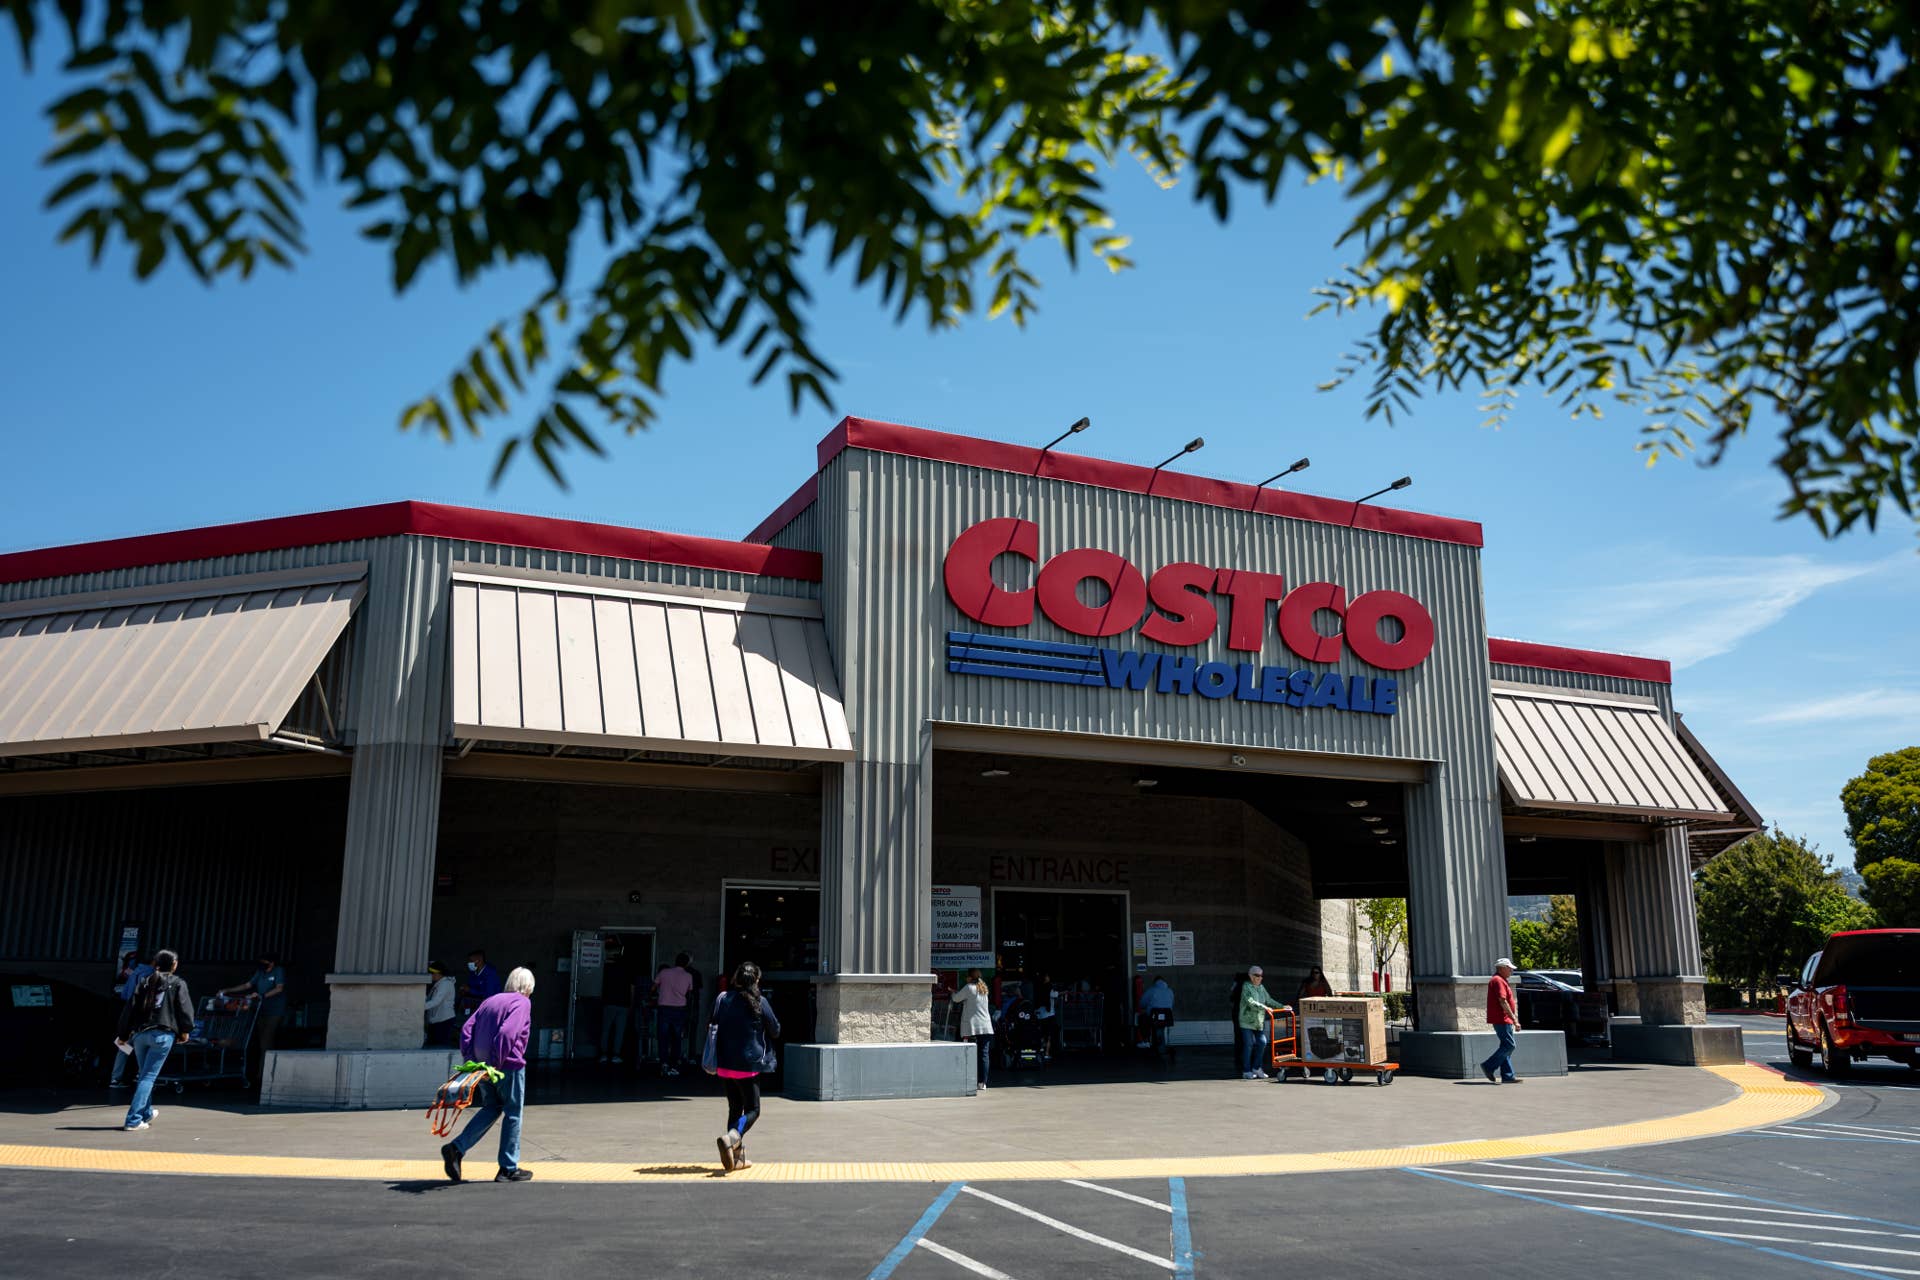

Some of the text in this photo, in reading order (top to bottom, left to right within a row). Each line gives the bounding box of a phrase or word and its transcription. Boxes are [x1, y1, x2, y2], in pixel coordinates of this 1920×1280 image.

[944, 517, 1434, 671] COSTCO
[1101, 649, 1398, 715] WHOLESALE
[772, 848, 818, 873] EXI
[991, 855, 1129, 884] ENTRANCE
